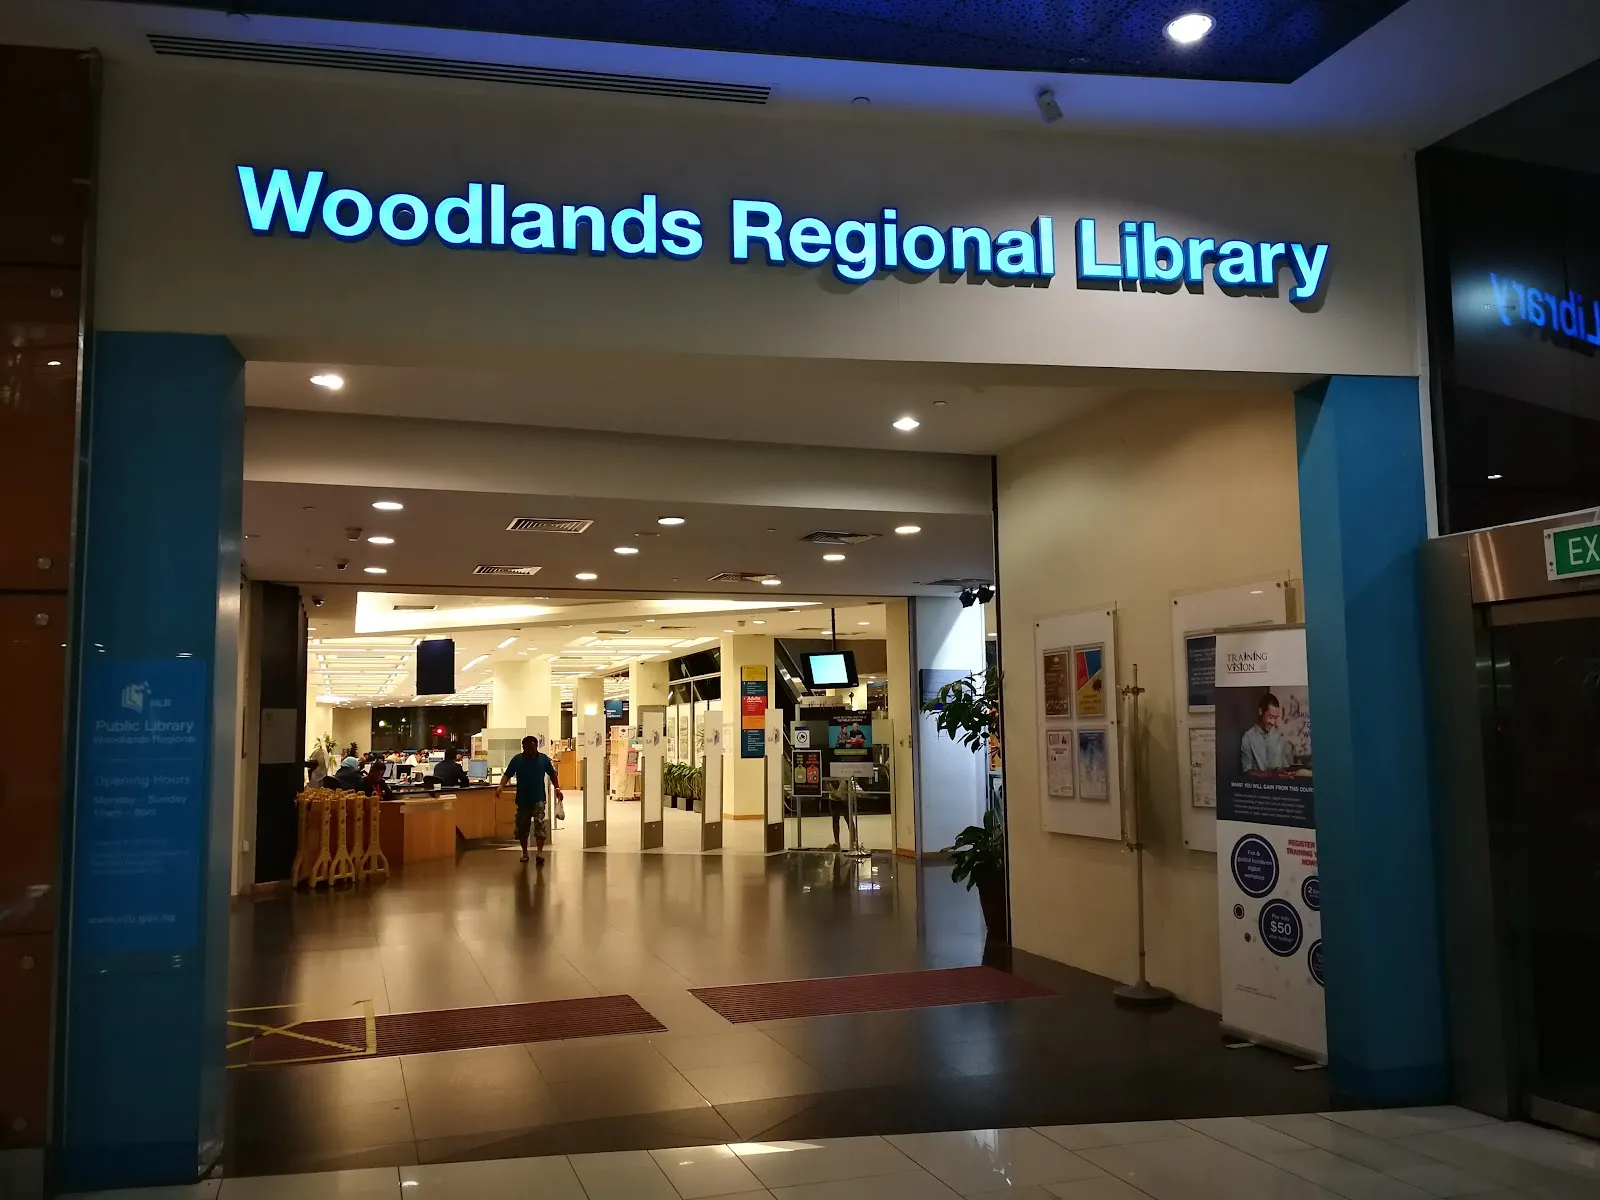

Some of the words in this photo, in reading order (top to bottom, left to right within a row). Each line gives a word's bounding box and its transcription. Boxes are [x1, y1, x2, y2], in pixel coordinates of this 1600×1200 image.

[236, 164, 705, 258] Woodlands
[730, 198, 1055, 283] Regional
[1077, 215, 1330, 301] Library
[1227, 652, 1268, 662] TRAINING
[1227, 662, 1255, 672] VISION
[95, 720, 140, 732] Public
[145, 719, 194, 734] Library
[94, 775, 150, 788] Opening
[153, 774, 191, 785] Hours
[147, 794, 187, 806] Sunday
[1288, 839, 1315, 848] REGISTER
[1287, 848, 1313, 857] TRAINING
[1308, 886, 1313, 894] 2
[1270, 920, 1292, 936] $50
